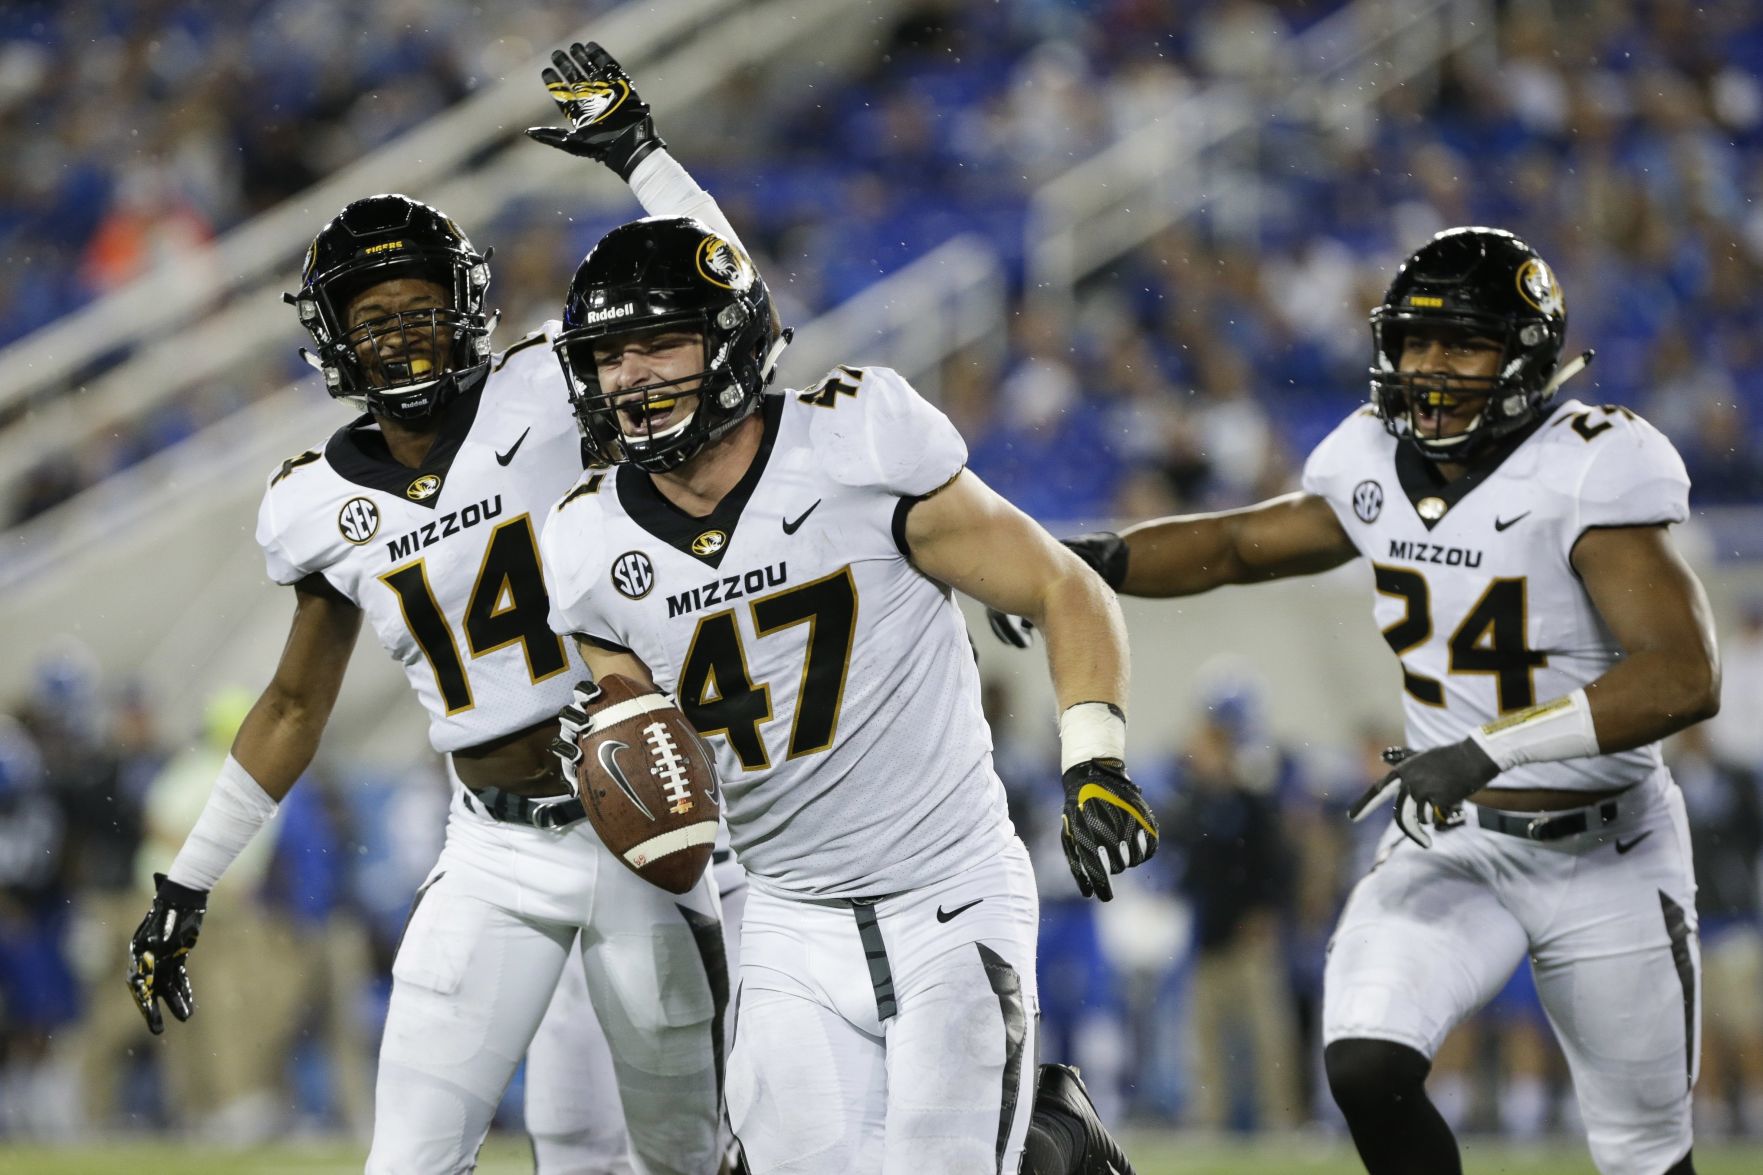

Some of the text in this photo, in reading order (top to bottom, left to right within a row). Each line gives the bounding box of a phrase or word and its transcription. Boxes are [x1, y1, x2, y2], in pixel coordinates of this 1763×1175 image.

[365, 241, 403, 255] TIGERS
[587, 302, 634, 324] Riddell
[401, 398, 429, 409] Riddell
[339, 497, 379, 544] SEC
[387, 494, 503, 562] MIZZOU
[611, 551, 653, 599] SEC
[1388, 540, 1483, 568] MIZZOU
[666, 561, 788, 618] MIZZOU
[377, 512, 571, 718] 14
[1372, 560, 1549, 716] 24
[676, 563, 860, 772] 47
